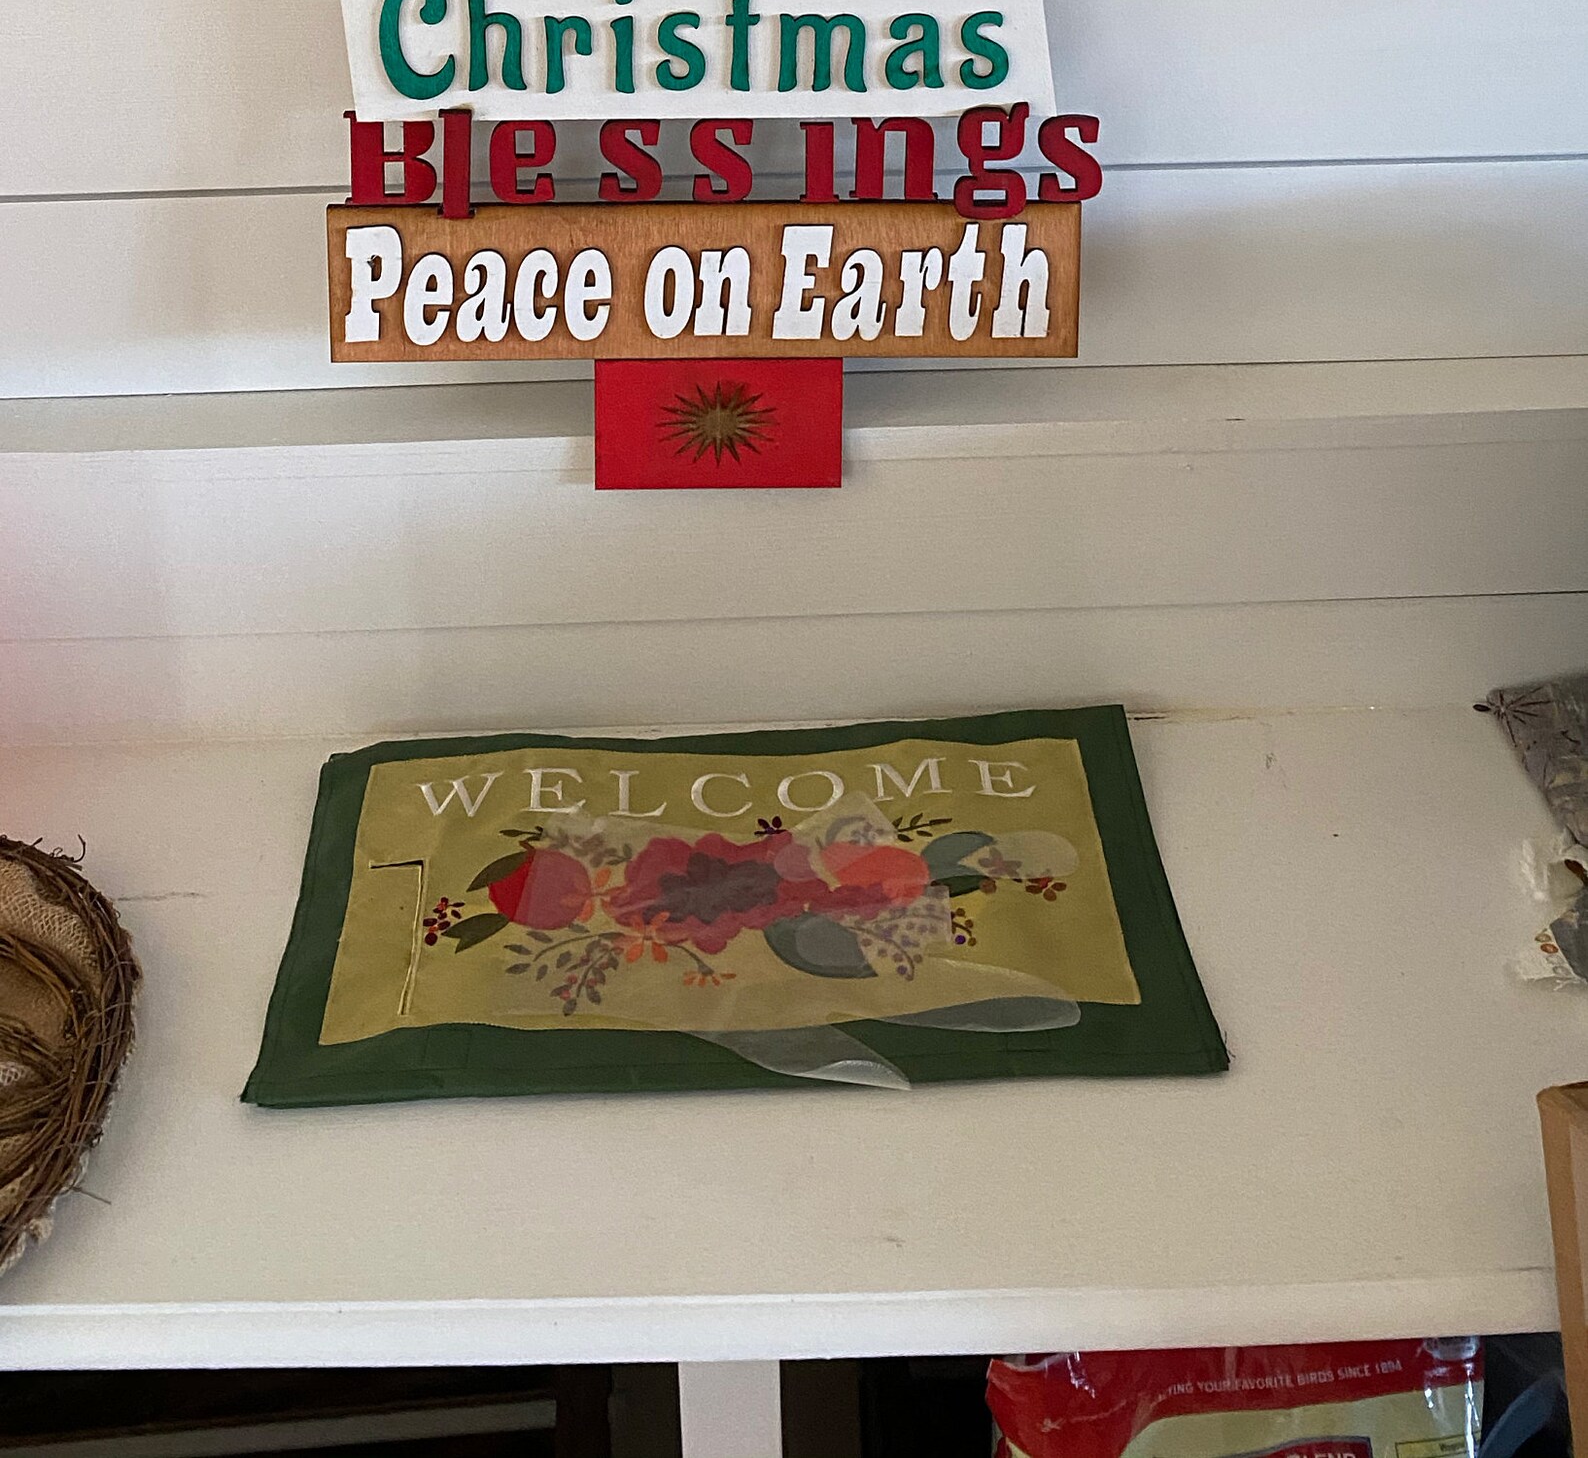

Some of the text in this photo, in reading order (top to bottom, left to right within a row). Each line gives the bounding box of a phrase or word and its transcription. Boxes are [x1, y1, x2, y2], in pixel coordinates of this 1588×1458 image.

[343, 101, 1103, 219] Blessings
[344, 222, 1050, 346] Peace on Earth
[415, 757, 1037, 818] WELCOME
[1197, 1380, 1232, 1393] YOUR
[1234, 1373, 1294, 1391] FAVORITE
[1297, 1369, 1335, 1386] BIRDS
[1337, 1363, 1372, 1381] SINCE
